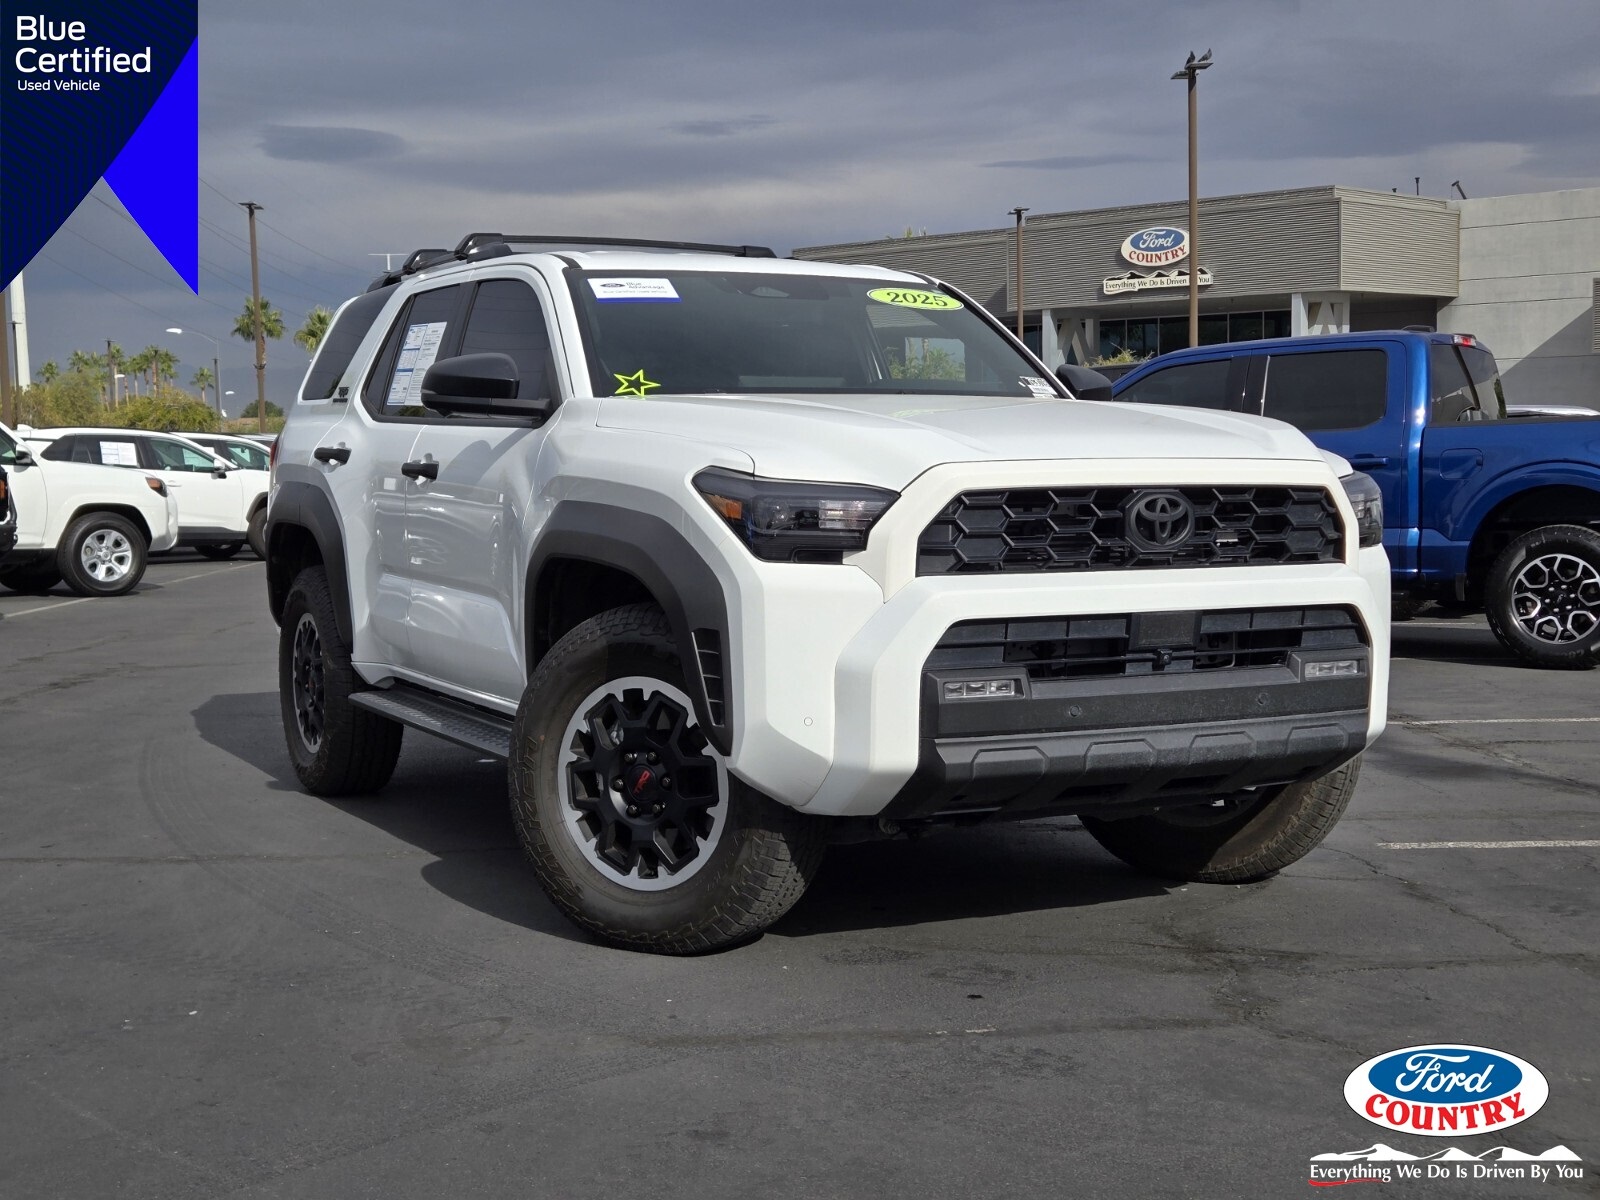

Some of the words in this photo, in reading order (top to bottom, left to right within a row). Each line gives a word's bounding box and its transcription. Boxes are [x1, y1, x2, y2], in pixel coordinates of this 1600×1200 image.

[1140, 231, 1174, 248] Ford
[1129, 245, 1187, 263] COUNTRY
[1105, 281, 1136, 289] Everything
[886, 291, 948, 307] 2025
